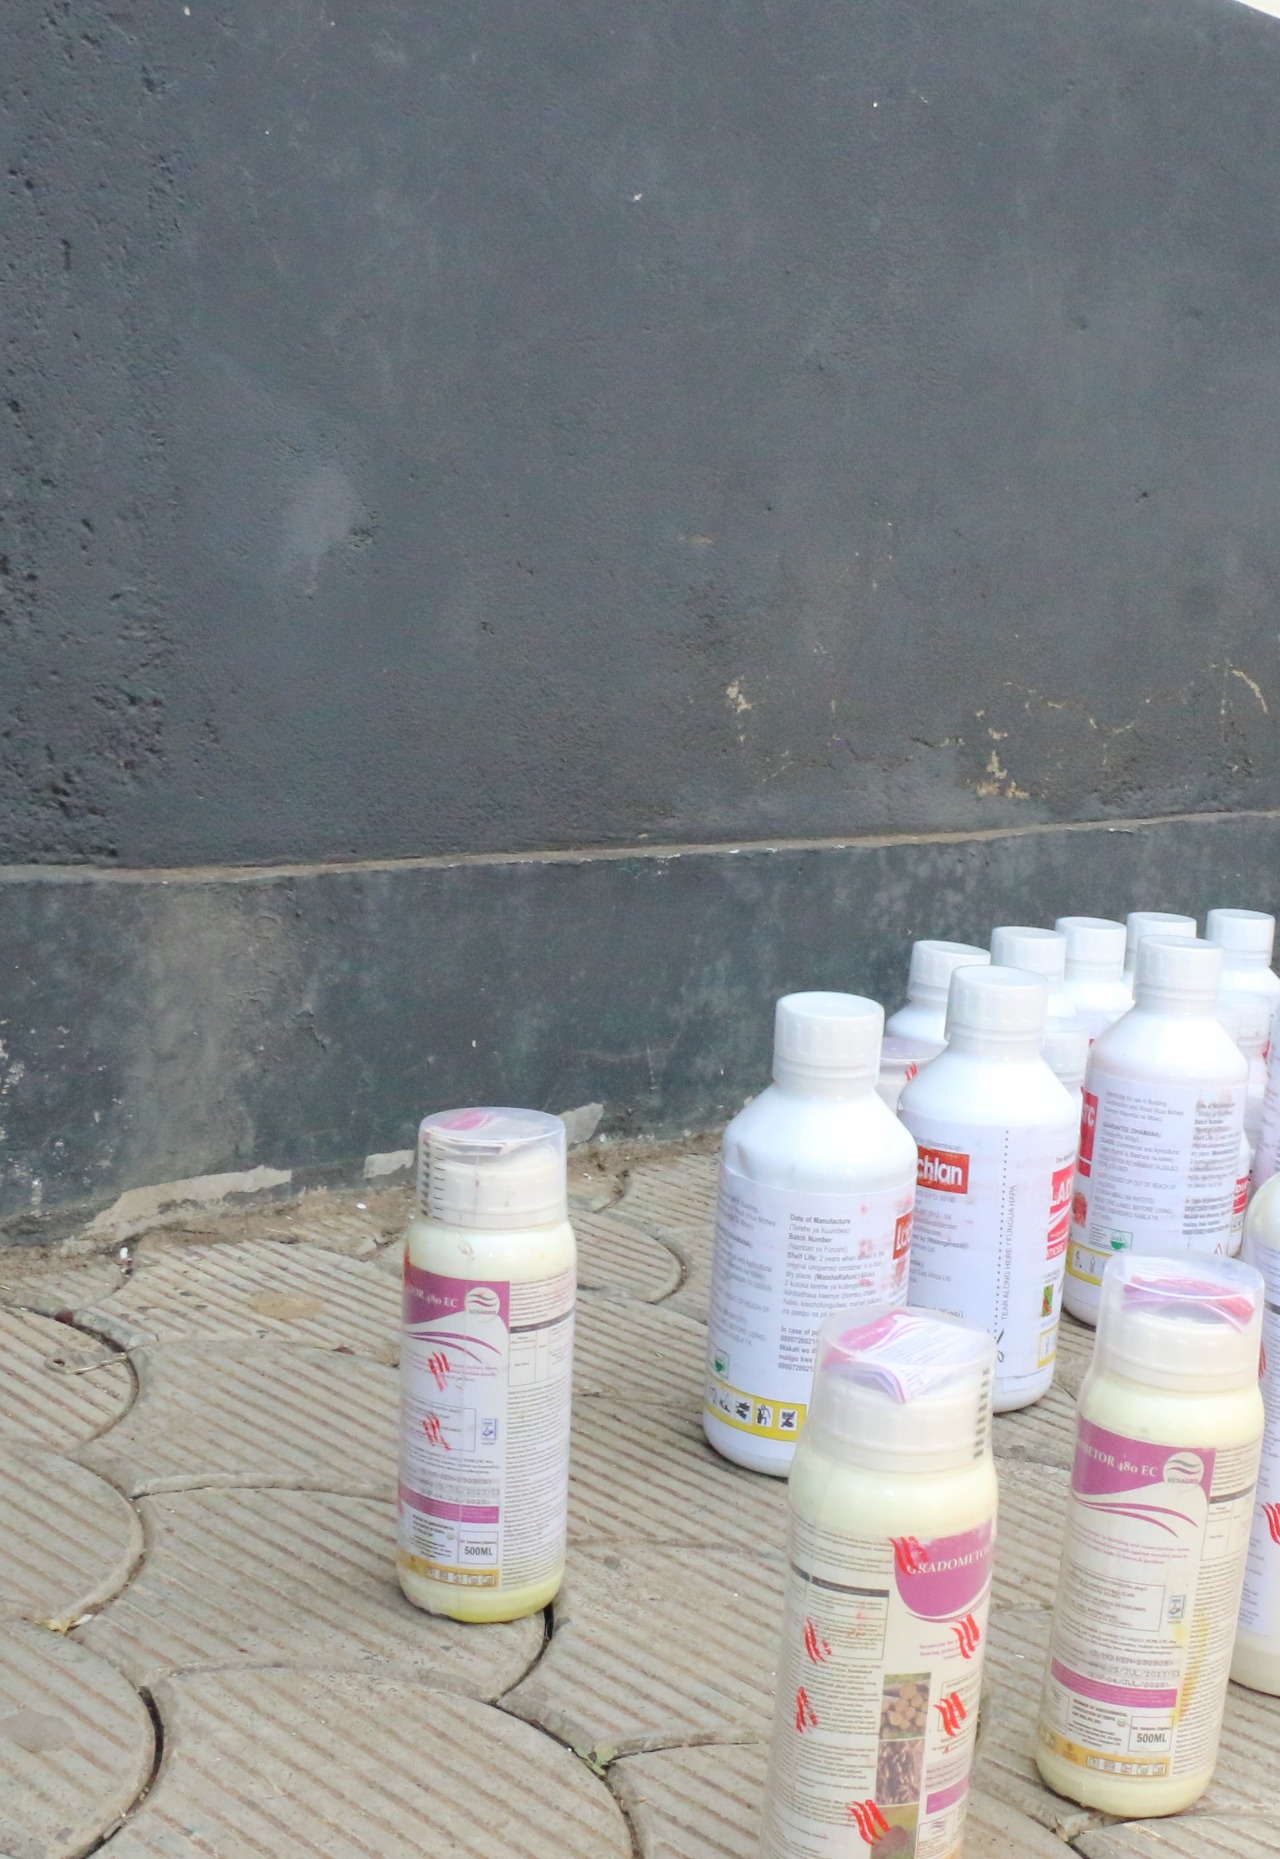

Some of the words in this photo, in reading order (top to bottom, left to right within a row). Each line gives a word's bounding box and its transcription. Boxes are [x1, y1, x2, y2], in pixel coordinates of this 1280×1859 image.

[790, 1213, 804, 1222] Date
[813, 1217, 851, 1225] Manufacture
[788, 1232, 807, 1241] Batch
[808, 1234, 832, 1243] Number
[787, 1251, 803, 1260] Shelf
[1004, 1247, 1013, 1270] HERE
[1002, 1270, 1011, 1300] ALONG
[443, 1297, 458, 1308] EC
[1001, 1300, 1009, 1321] TEAR
[1117, 1459, 1139, 1473] 480
[1141, 1464, 1159, 1477] EC
[464, 1546, 493, 1557] 500ML
[1136, 1732, 1167, 1744] 500ML
